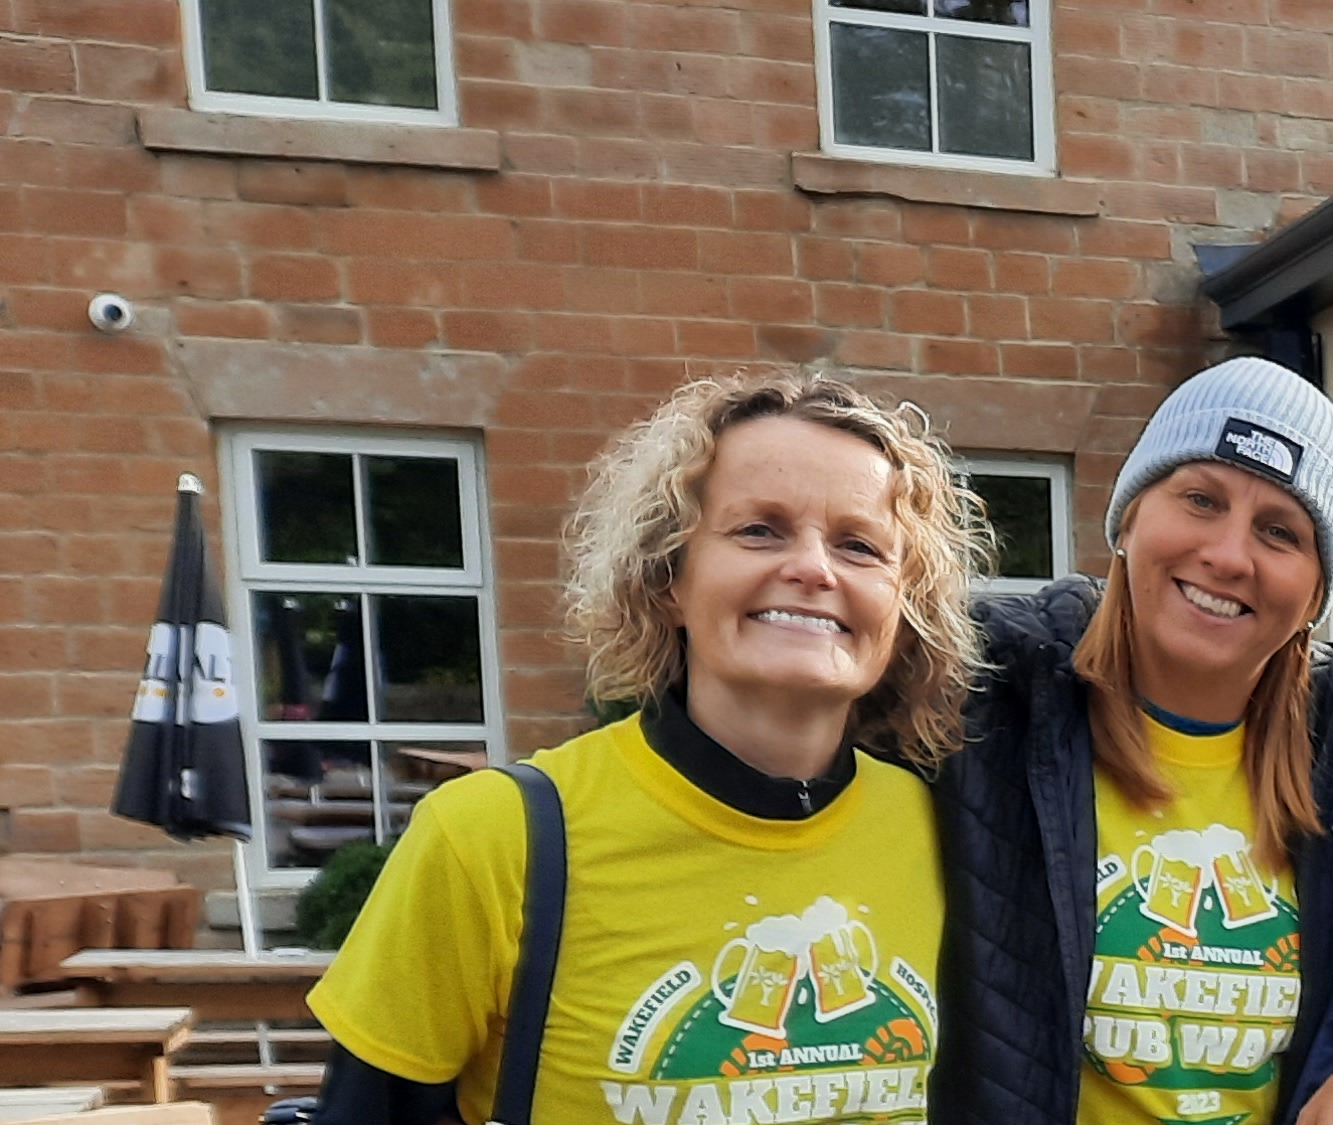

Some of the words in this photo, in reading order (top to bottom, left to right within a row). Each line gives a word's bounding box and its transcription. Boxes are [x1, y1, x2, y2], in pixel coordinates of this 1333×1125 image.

[1225, 432, 1274, 456] NORTH
[1236, 445, 1271, 464] FACE
[1163, 942, 1189, 960] 1st
[1190, 945, 1265, 966] ANNUAL
[1087, 960, 1301, 1017] AKEFIE
[614, 968, 692, 1066] WAKEFIELD
[1084, 1014, 1170, 1063] UB
[749, 1052, 777, 1069] 1st
[779, 1043, 864, 1067] ANNUAL
[1176, 1090, 1221, 1116] 2023
